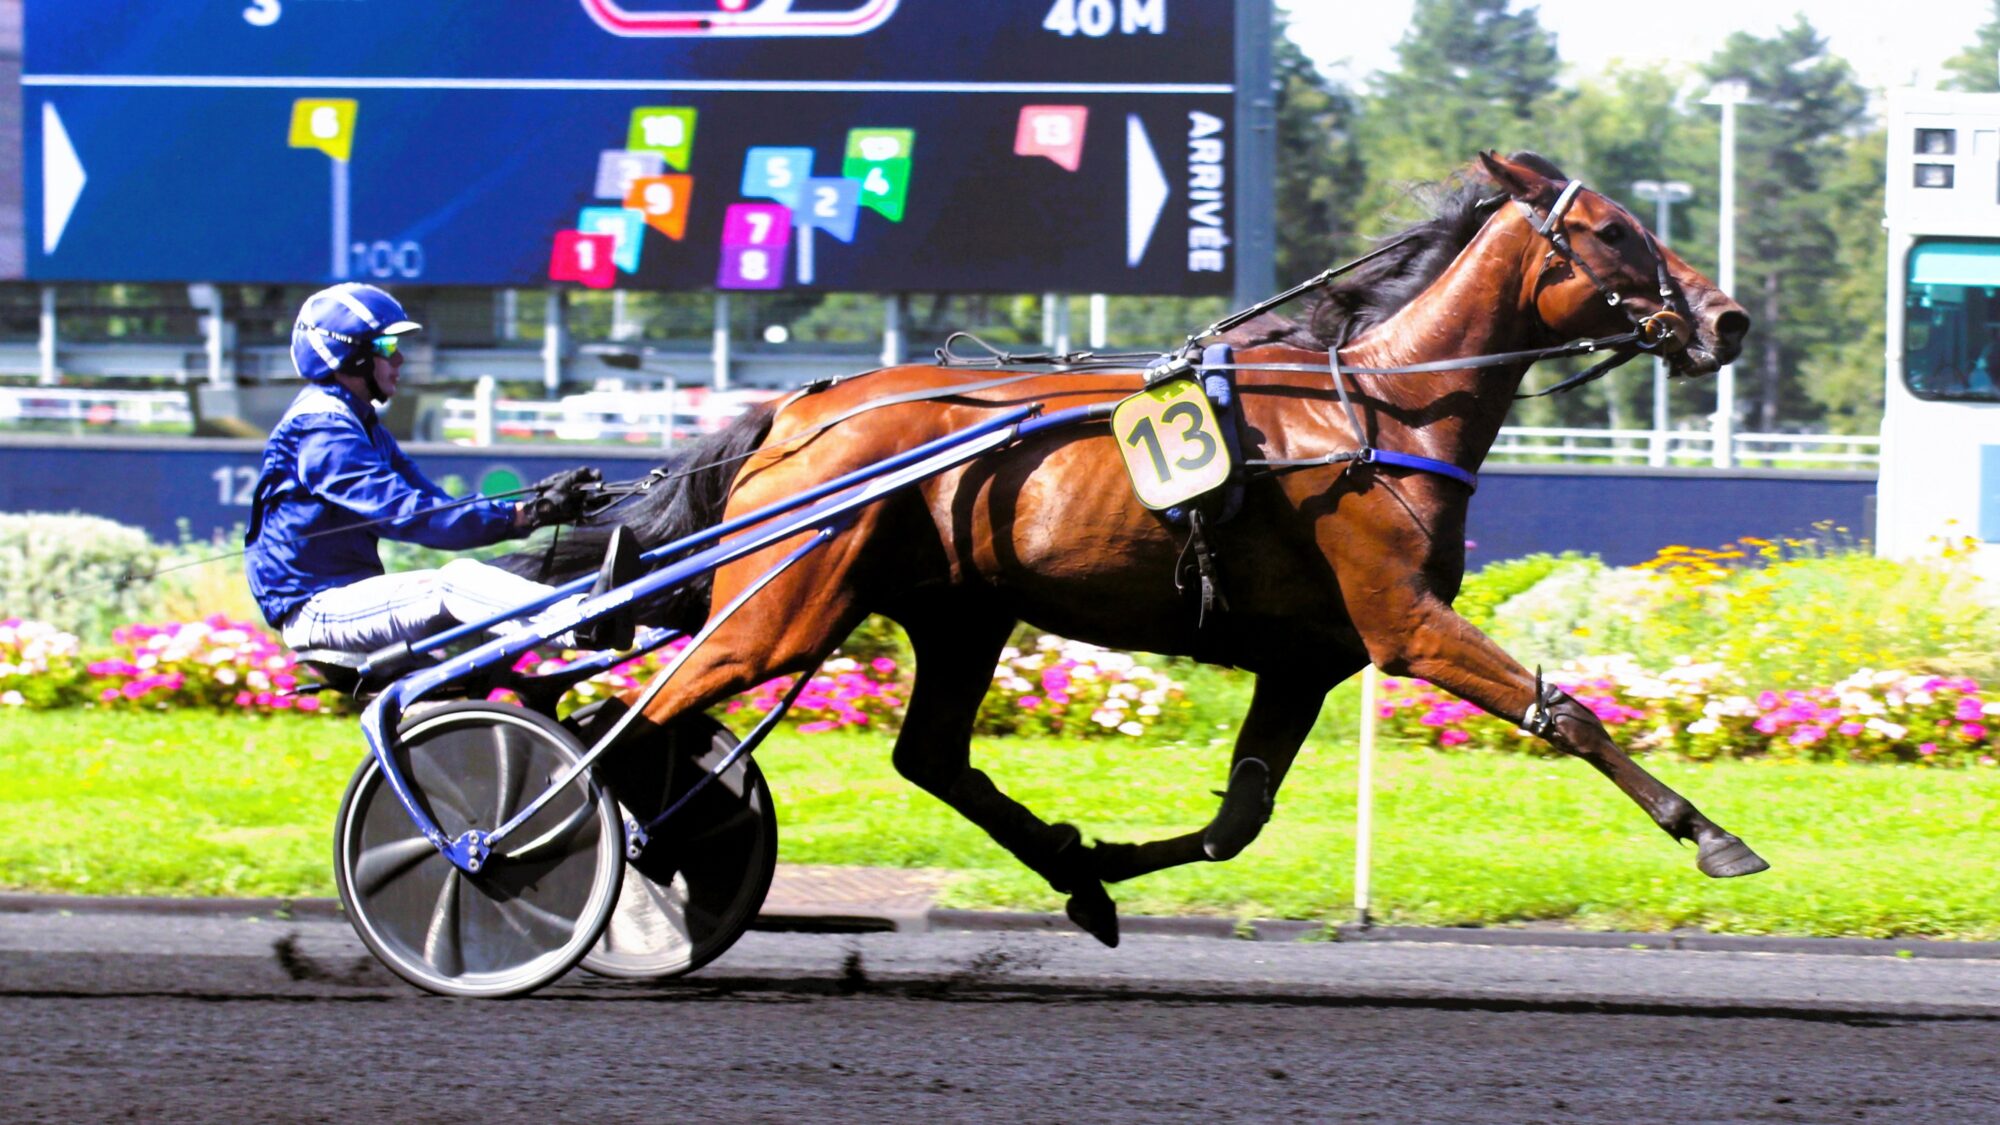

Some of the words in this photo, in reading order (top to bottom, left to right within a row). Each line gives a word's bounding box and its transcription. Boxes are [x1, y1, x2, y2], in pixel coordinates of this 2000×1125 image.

[311, 106, 340, 139] 6
[1032, 115, 1073, 146] 13
[766, 156, 792, 188] 5
[864, 167, 889, 196] 4
[644, 183, 673, 215] 9
[814, 186, 839, 217] 2
[1188, 110, 1230, 272] ARRIVÉE
[746, 212, 772, 244] 7
[351, 241, 421, 278] 100
[575, 240, 595, 271] 1
[740, 250, 768, 281] 8
[1126, 401, 1217, 483] 13
